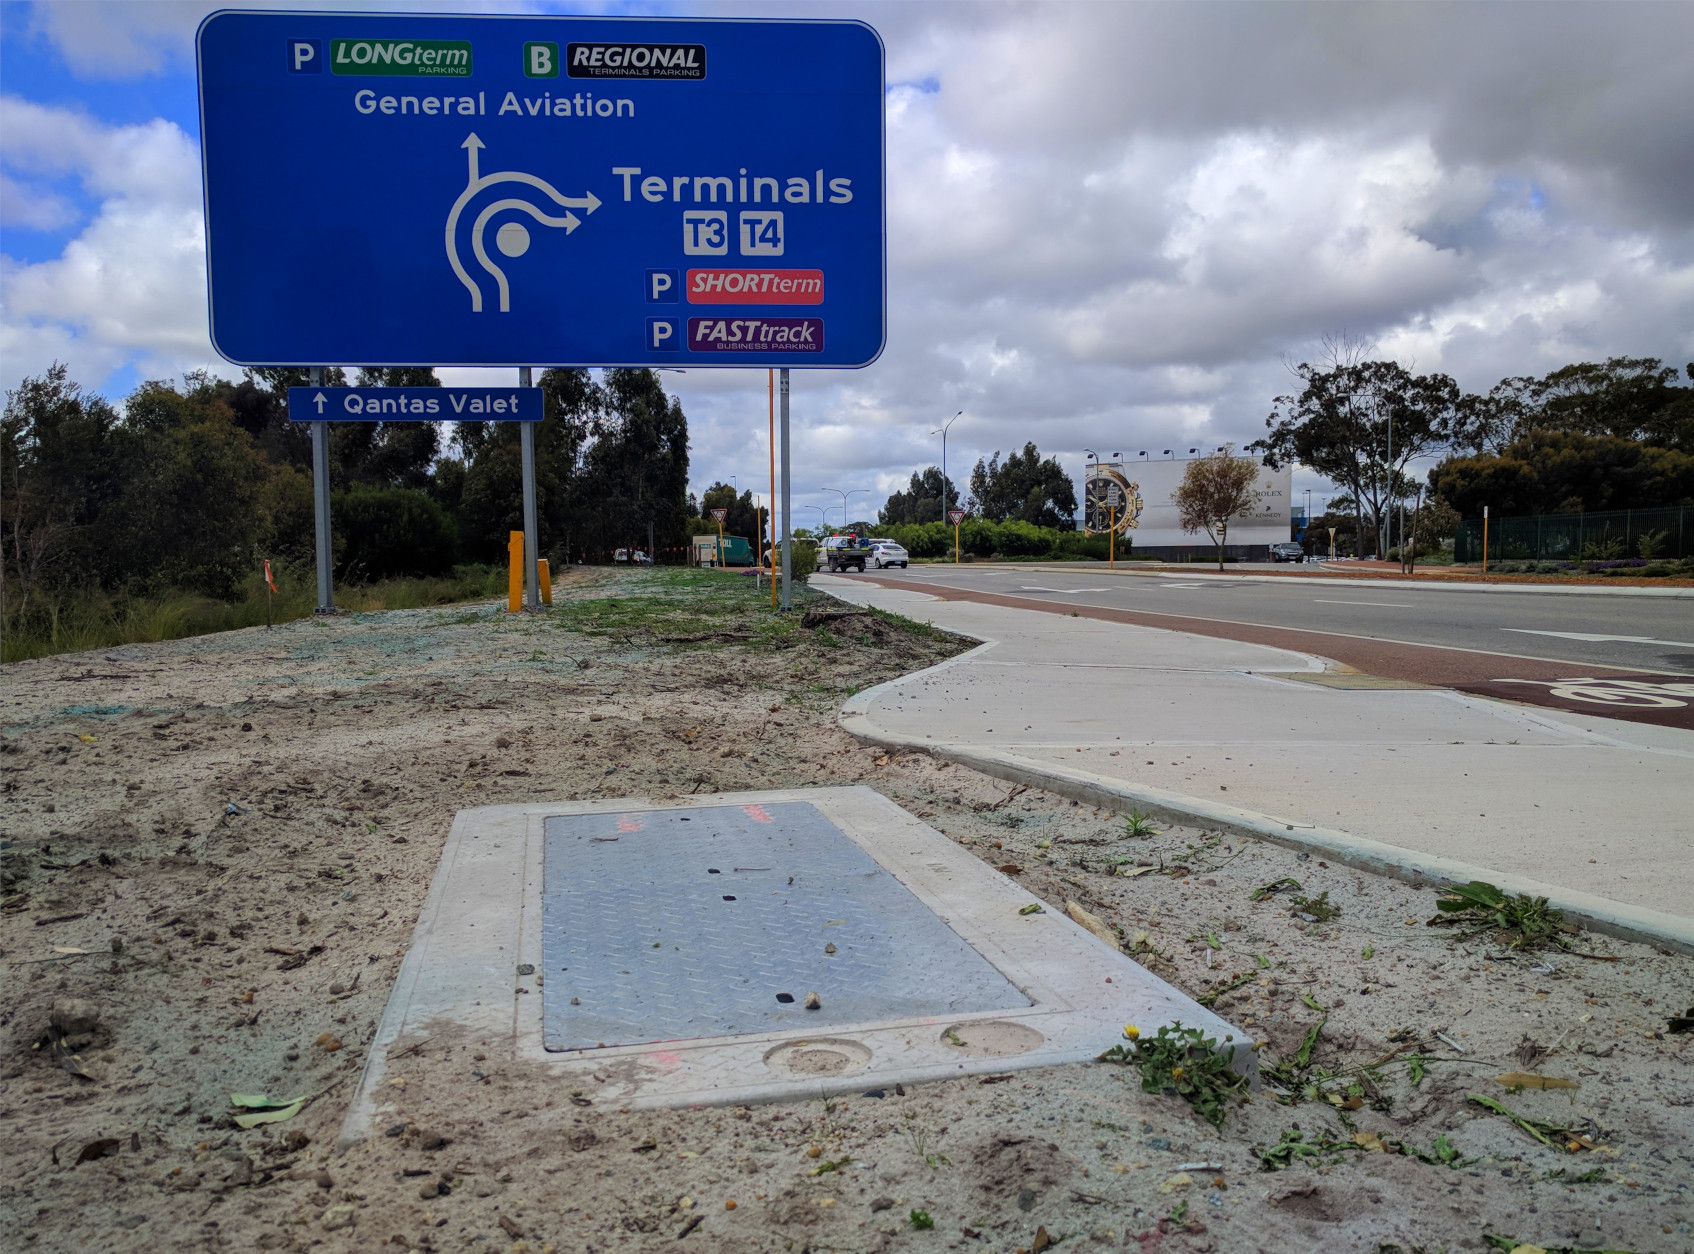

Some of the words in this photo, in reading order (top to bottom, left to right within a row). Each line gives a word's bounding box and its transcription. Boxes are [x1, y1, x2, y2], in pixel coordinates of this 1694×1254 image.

[293, 42, 315, 70] P
[336, 42, 468, 65] LONGterm
[530, 45, 552, 74] B
[572, 46, 700, 68] REGIONAL
[418, 66, 467, 75] PARKING
[588, 67, 650, 76] TERMINALS
[653, 68, 700, 77] PARKING
[354, 89, 486, 116] General
[498, 91, 635, 117] Aviation
[612, 167, 853, 204] Terminals
[685, 217, 726, 249] T3
[742, 218, 781, 249] T4
[652, 273, 672, 299] P
[692, 273, 821, 293] SHORTterm
[653, 321, 673, 347] P
[695, 321, 815, 342] FASTtrack
[716, 342, 768, 350] BUSINESS
[344, 394, 440, 415] Qantas
[449, 394, 519, 414] Valet
